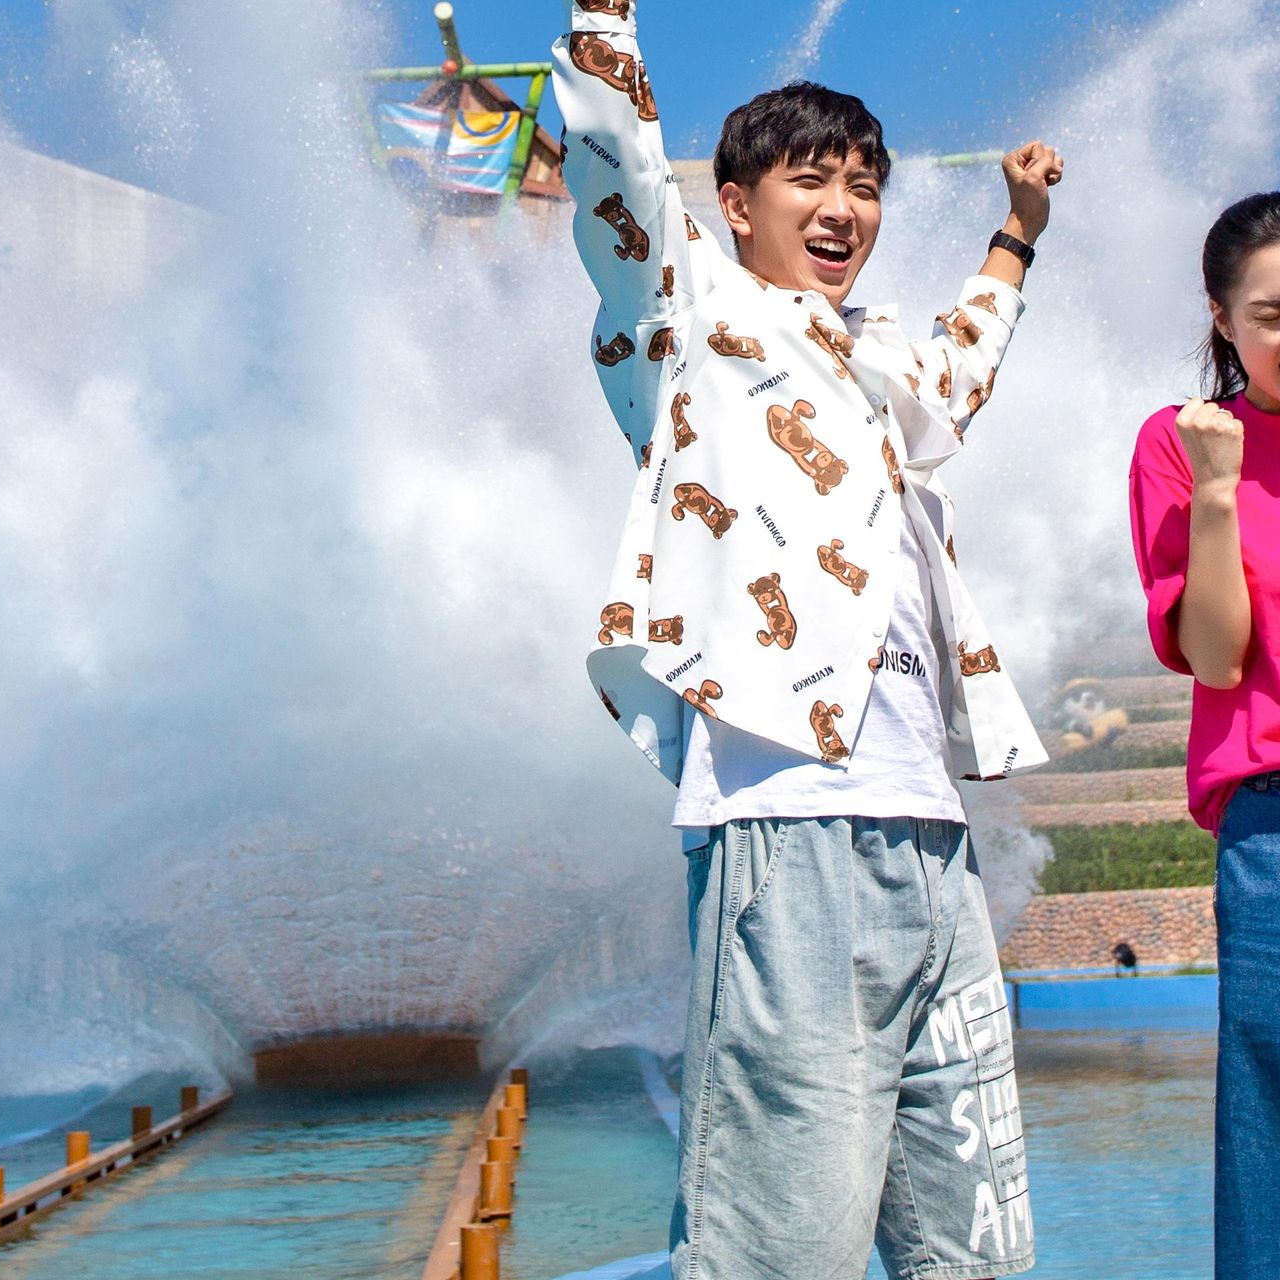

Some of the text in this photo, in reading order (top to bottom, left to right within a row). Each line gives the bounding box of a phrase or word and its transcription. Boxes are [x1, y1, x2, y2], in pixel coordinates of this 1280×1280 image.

[581, 135, 620, 169] NEVERHOOD
[748, 370, 790, 397] NEVERHOOD
[651, 457, 667, 504] NEVERHOOD
[756, 505, 786, 548] NEVERHOOD
[665, 651, 702, 682] NEVERHOOD
[793, 665, 834, 692] NEVERHOOD
